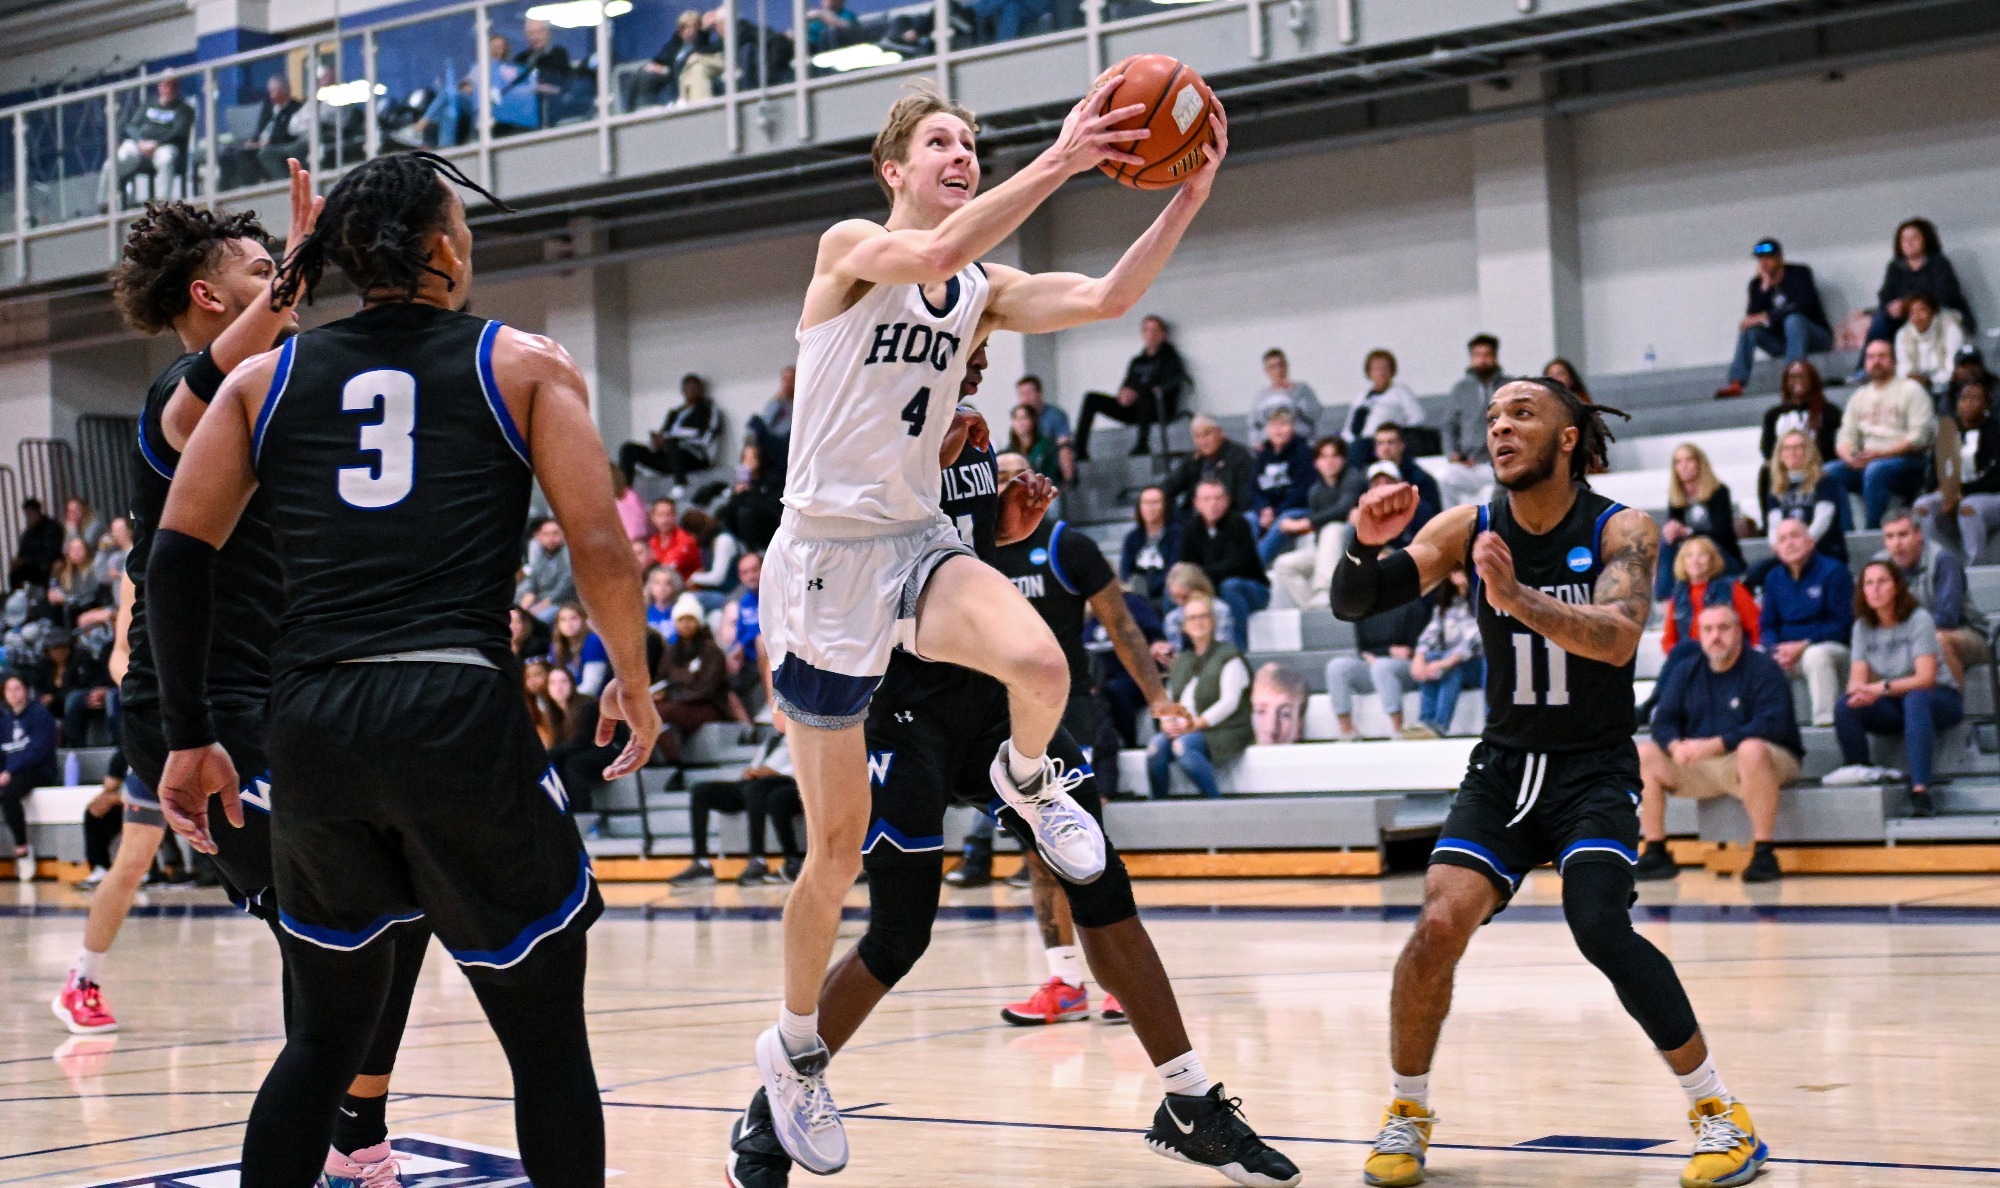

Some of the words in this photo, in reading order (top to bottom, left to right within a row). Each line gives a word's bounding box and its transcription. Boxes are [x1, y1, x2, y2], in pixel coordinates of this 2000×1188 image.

[864, 322, 961, 371] HOO
[901, 386, 931, 437] 4
[337, 367, 418, 510] 3
[942, 461, 997, 501] ILSON
[1511, 633, 1570, 705] 11
